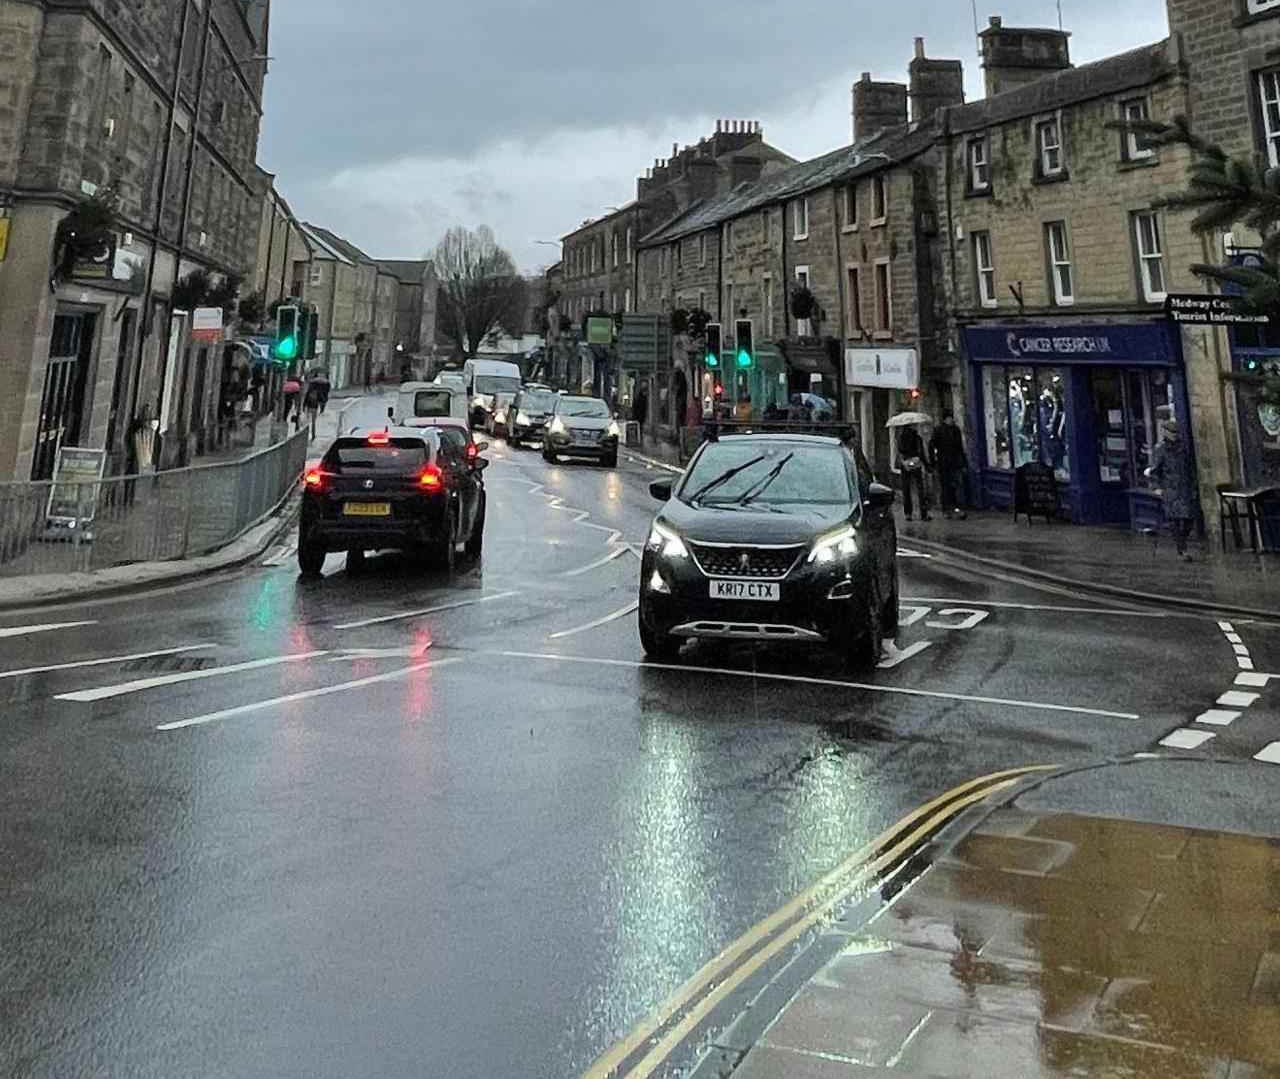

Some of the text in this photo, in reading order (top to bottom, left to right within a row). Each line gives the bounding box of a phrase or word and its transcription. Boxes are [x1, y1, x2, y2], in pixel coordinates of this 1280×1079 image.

[1171, 298, 1210, 309] Medway
[717, 582, 773, 598] KR17 CTX
